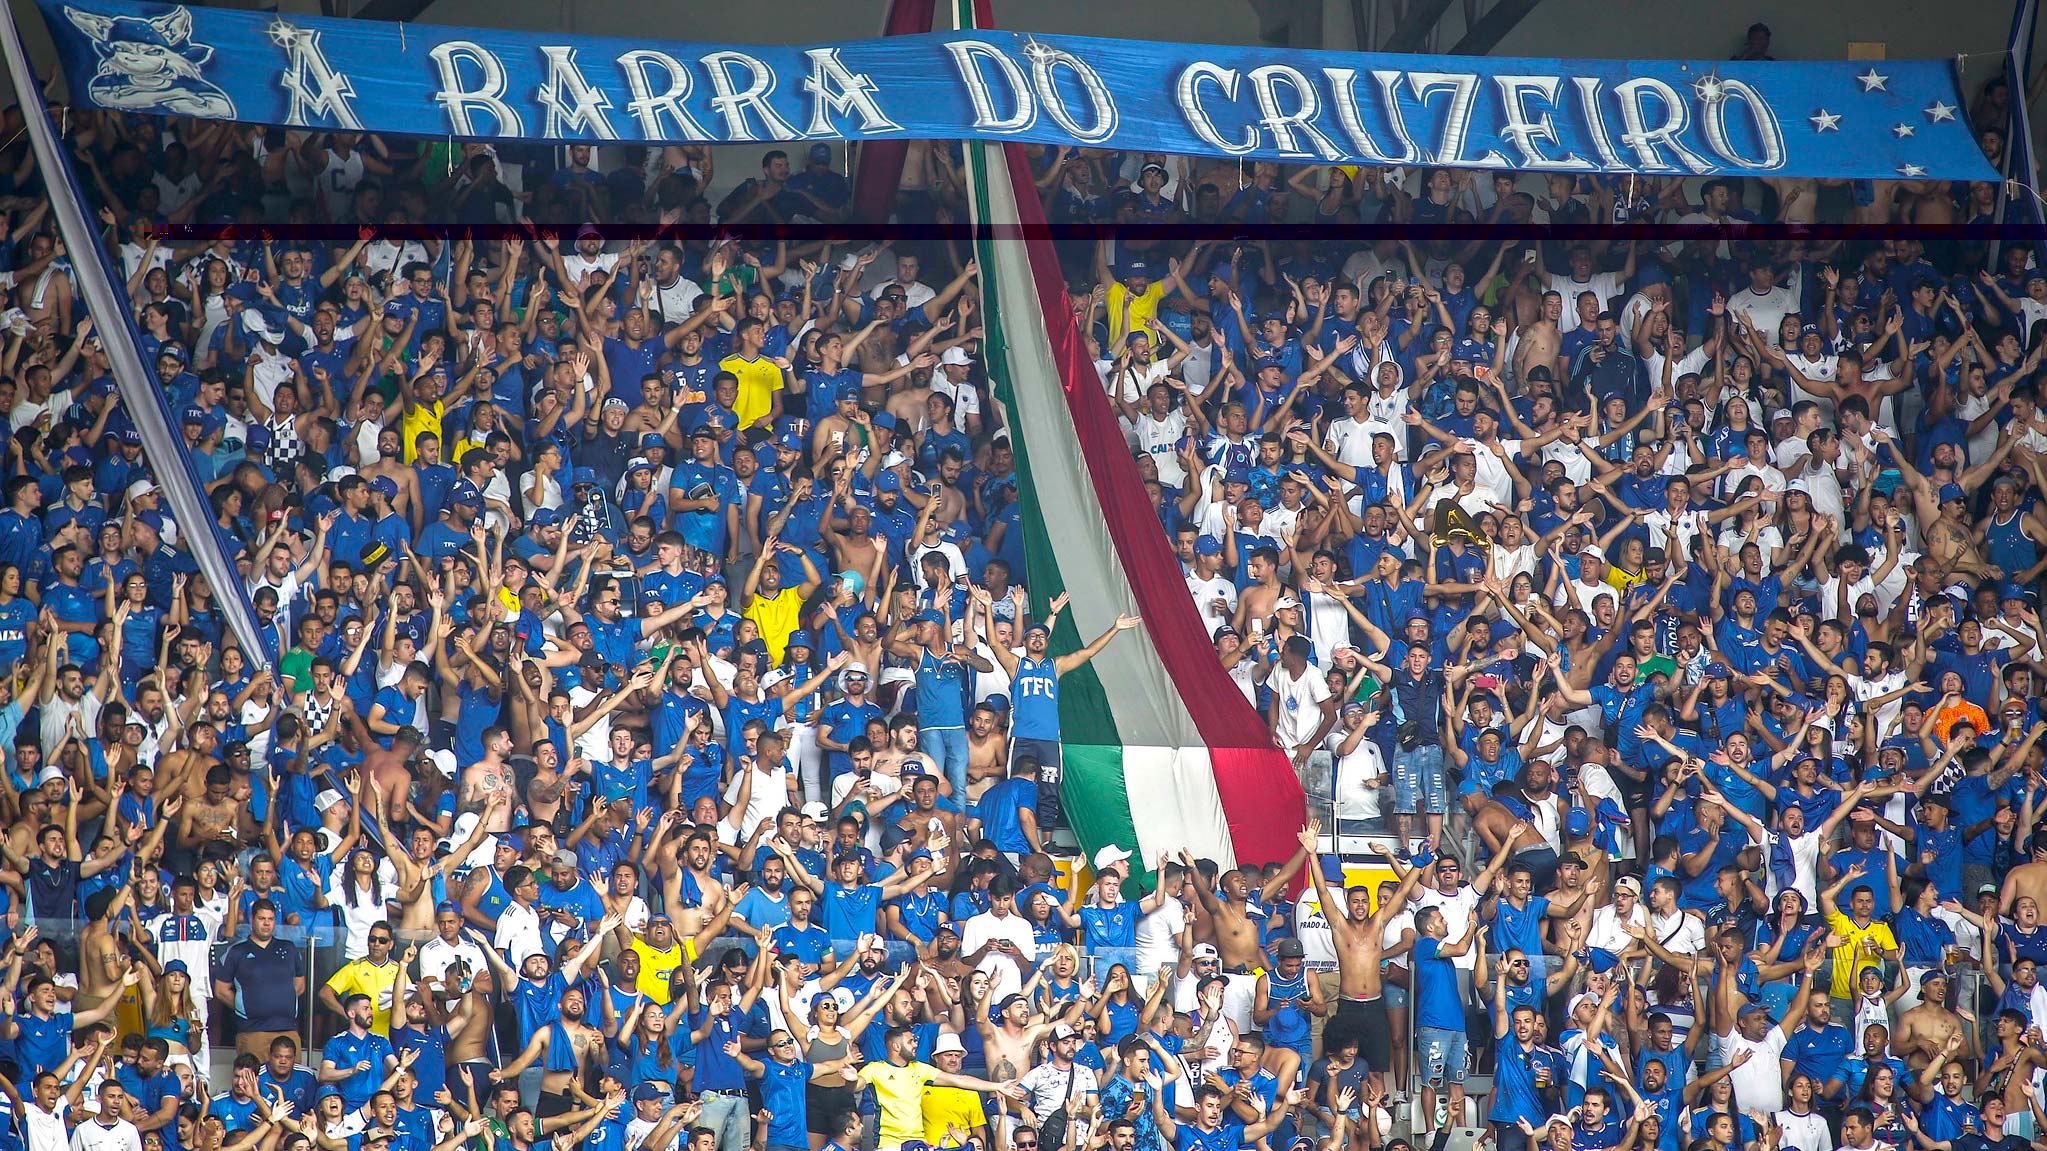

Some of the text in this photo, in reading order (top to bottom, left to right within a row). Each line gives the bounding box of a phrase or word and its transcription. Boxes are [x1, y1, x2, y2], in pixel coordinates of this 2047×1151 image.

[280, 29, 1788, 174] A BARRA DO CRUZEIRO
[389, 302, 403, 311] TFC
[1802, 323, 1817, 332] TFC
[188, 409, 203, 418] TFC
[125, 430, 140, 440] TFC
[1150, 443, 1174, 454] CAIX
[443, 541, 457, 549] TFC
[645, 589, 660, 598] TFC
[1020, 676, 1055, 700] TFC
[904, 764, 919, 772] TFC
[1300, 921, 1320, 929] PRADO
